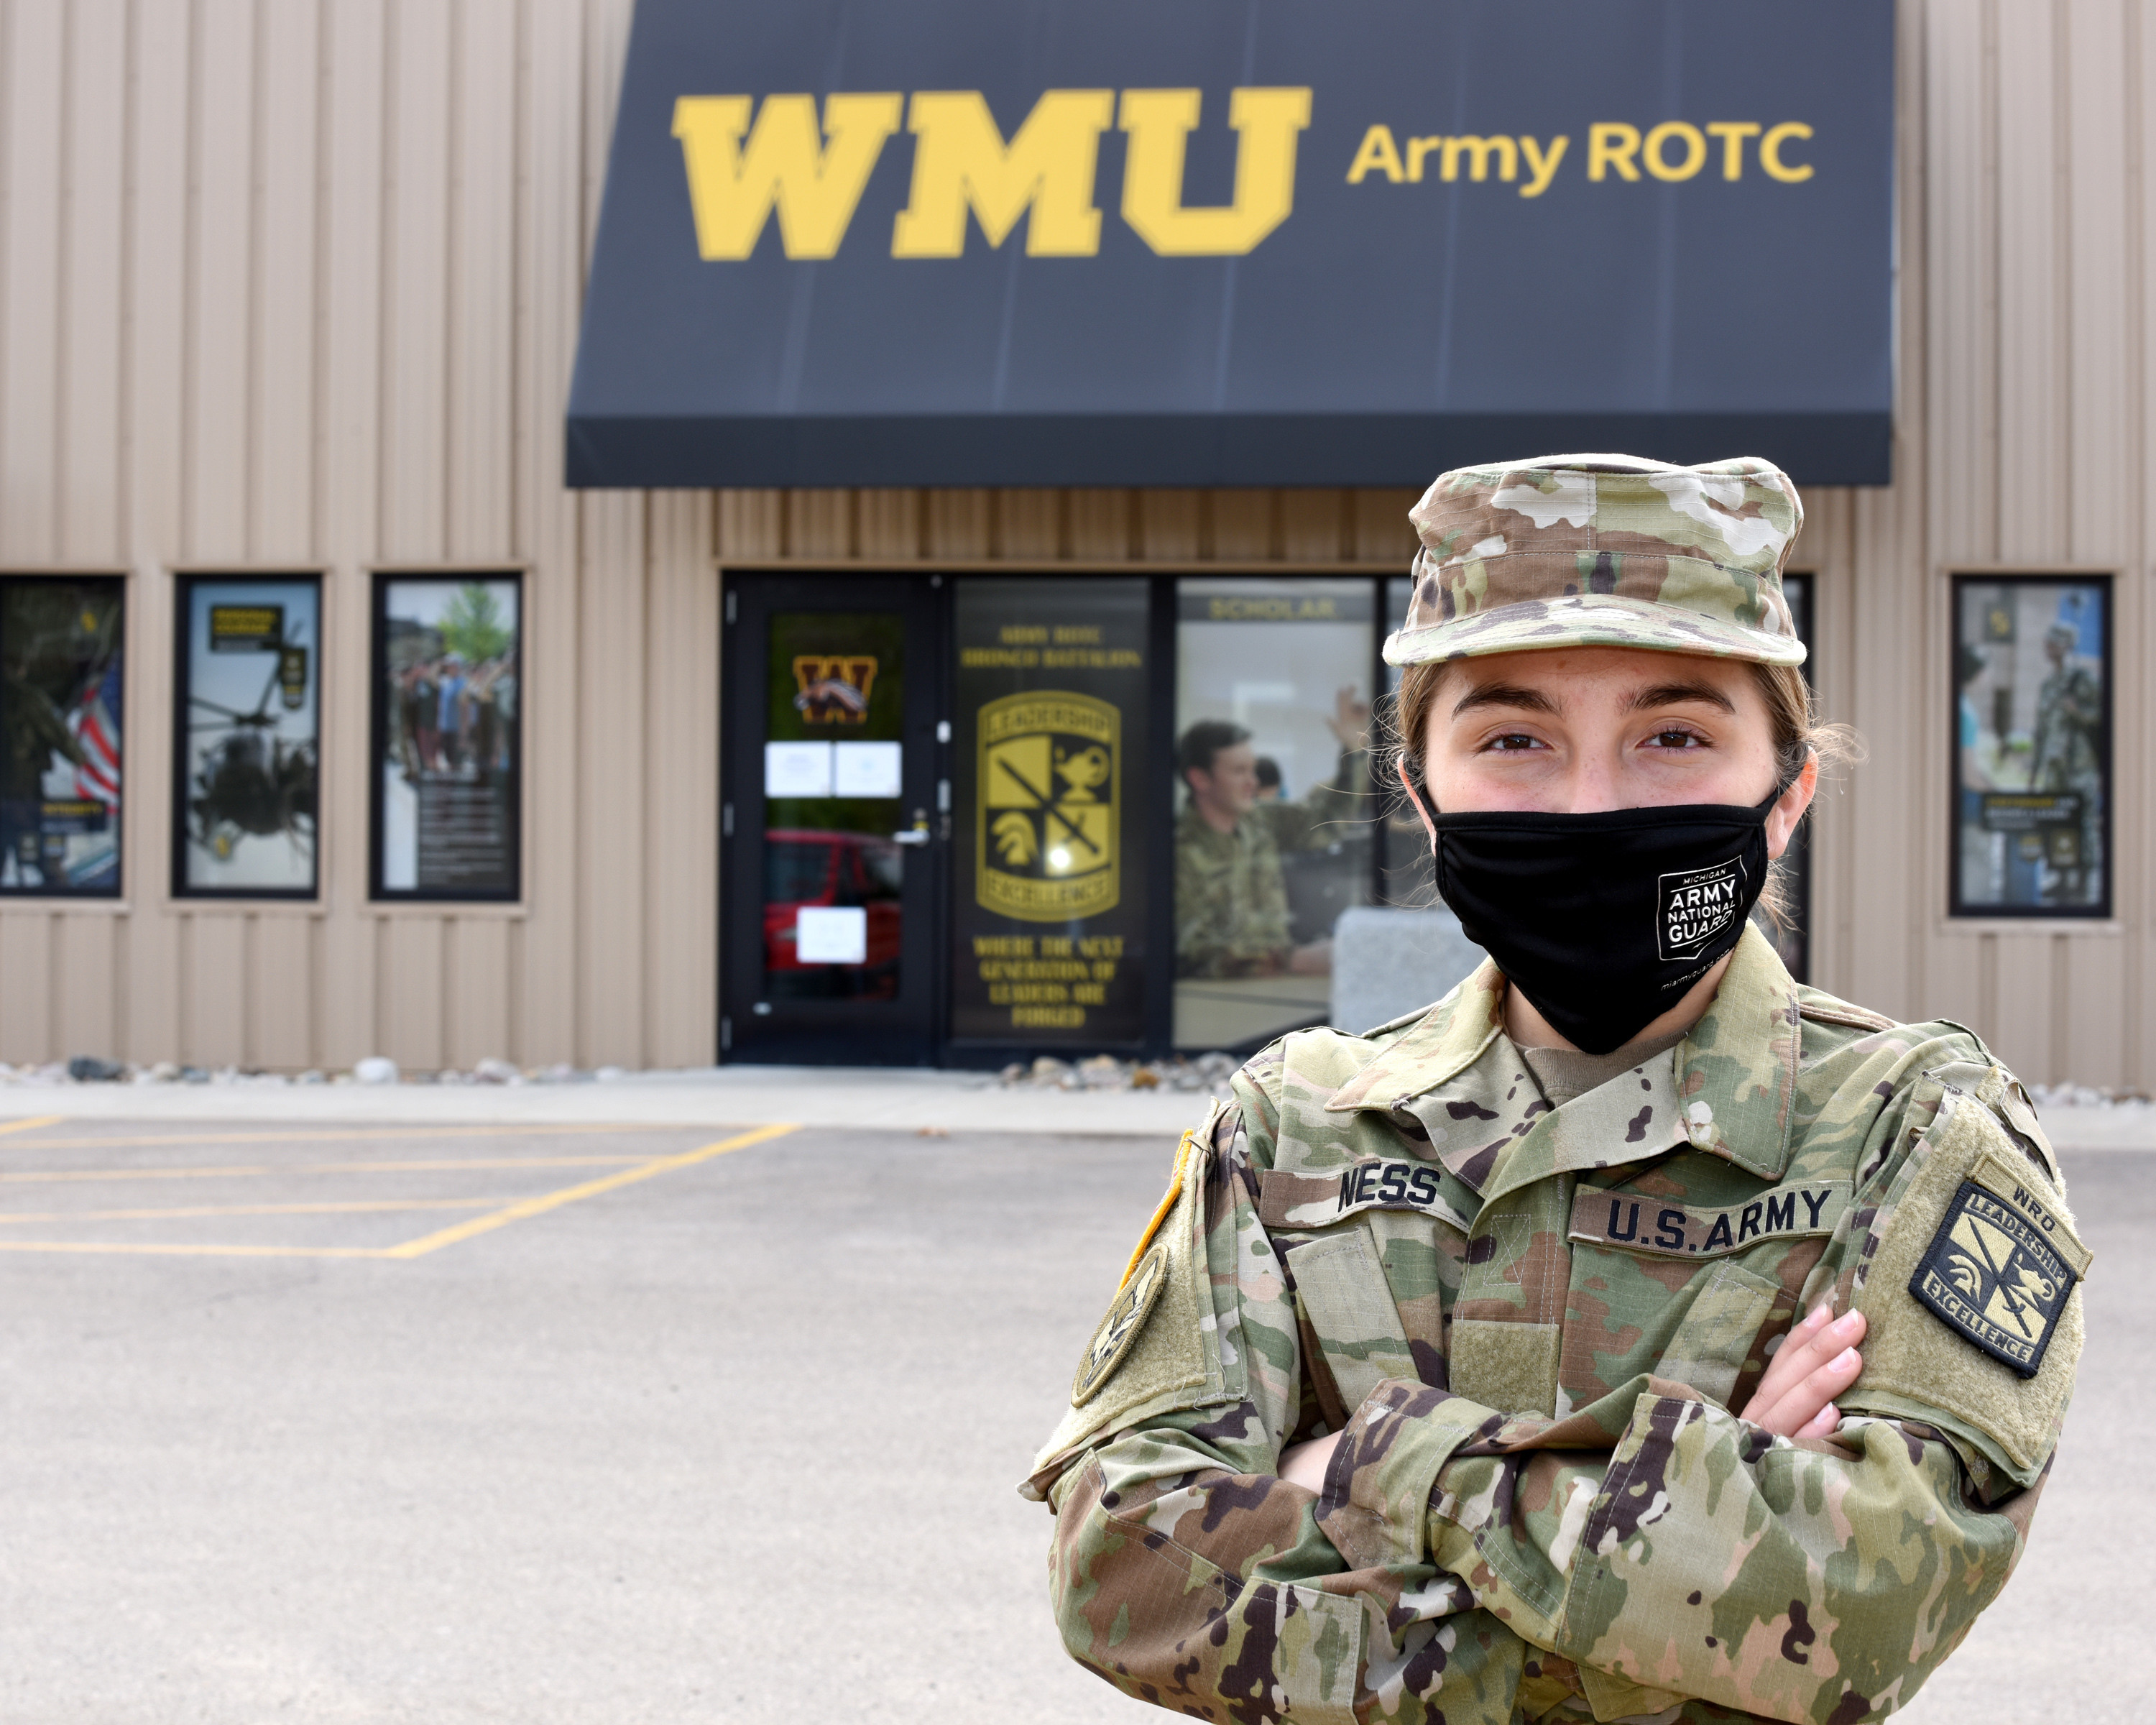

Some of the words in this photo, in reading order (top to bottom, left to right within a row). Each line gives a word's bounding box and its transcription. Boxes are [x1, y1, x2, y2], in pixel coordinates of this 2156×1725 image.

[673, 87, 1312, 259] WMU
[1348, 124, 1567, 198] Army
[1589, 121, 1813, 183] ROTC
[1209, 597, 1337, 620] SCHOLAR
[989, 704, 1110, 737] LEADERSHIP
[1682, 868, 1727, 886] MICHIGAN
[1669, 879, 1736, 911] ARMY
[1667, 900, 1736, 924] NATIONAL
[1668, 910, 1733, 943] GUARD
[1661, 948, 1731, 991] miarmyguardcom
[1338, 1163, 1441, 1213] NESS
[1970, 1194, 2068, 1280] LEADERSHIP
[1926, 1277, 2033, 1360] EXCELLENCE
